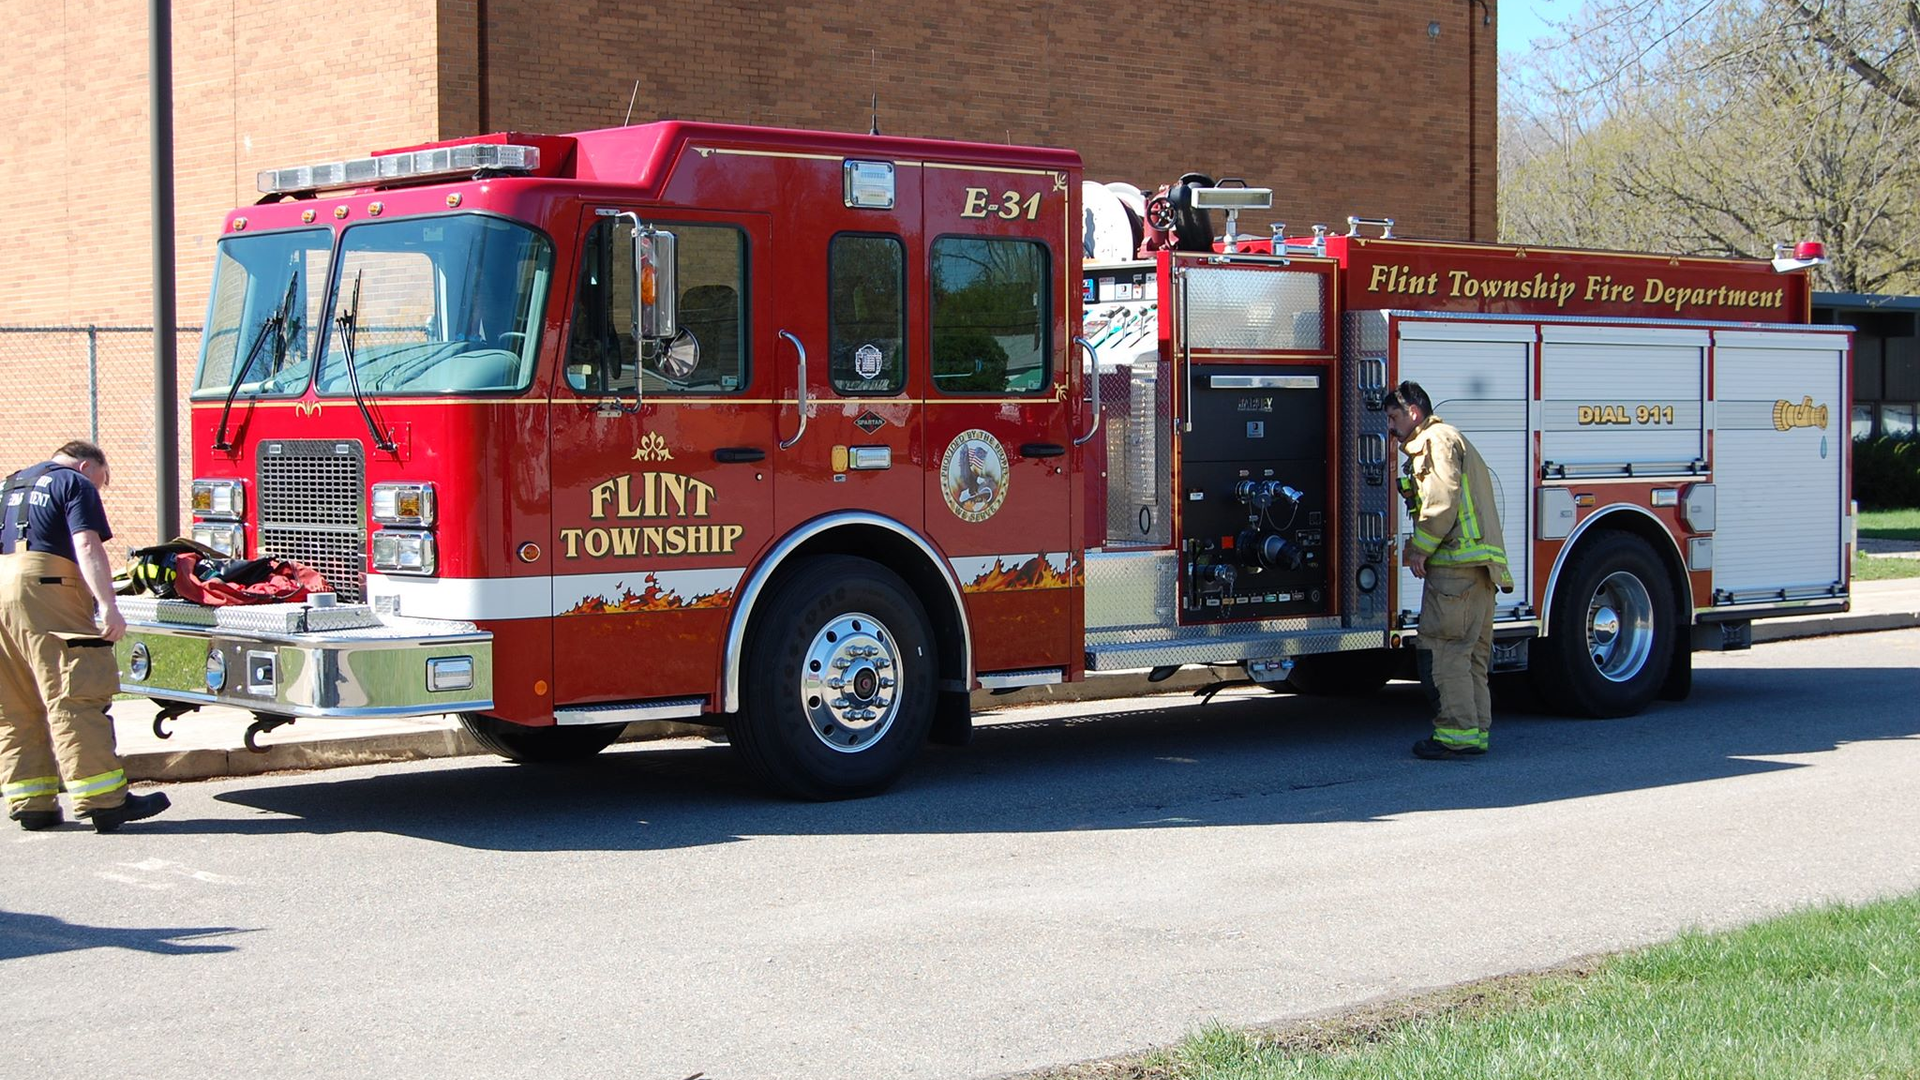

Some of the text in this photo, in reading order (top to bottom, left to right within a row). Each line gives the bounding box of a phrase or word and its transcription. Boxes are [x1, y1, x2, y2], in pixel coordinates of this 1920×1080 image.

[960, 187, 1041, 220] E-31
[1368, 264, 1784, 312] Flint Township Fire Department
[857, 418, 883, 426] SPARTAN
[1578, 405, 1674, 425] DIAL 911
[941, 434, 965, 478] PROVIDED
[966, 430, 977, 440] BY
[979, 431, 995, 445] THE
[590, 471, 717, 519] FLINT
[954, 505, 997, 521] WE SERVE
[560, 523, 744, 558] TOWNSHIP
